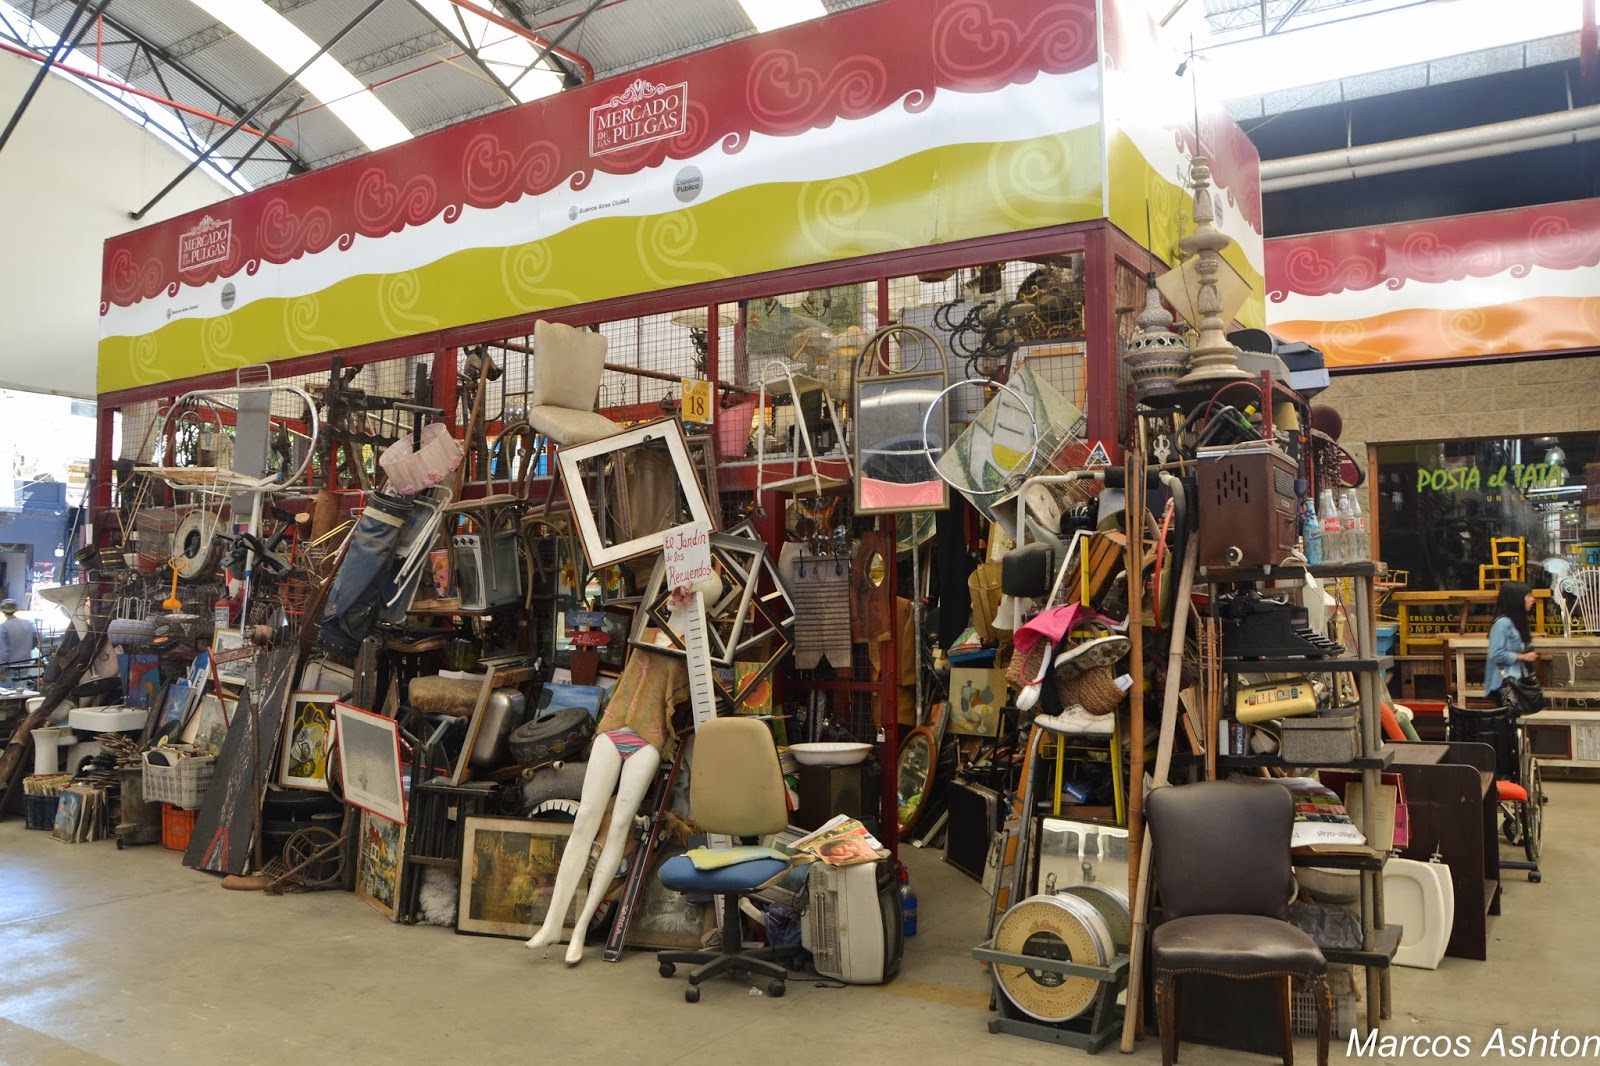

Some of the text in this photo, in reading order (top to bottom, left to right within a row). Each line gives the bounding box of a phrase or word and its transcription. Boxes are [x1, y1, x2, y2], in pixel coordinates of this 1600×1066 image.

[597, 94, 679, 131] MERCADO
[612, 111, 678, 143] PULGAS
[597, 130, 609, 140] DE
[597, 138, 611, 148] LAS
[675, 175, 700, 187] Espacio
[676, 183, 700, 193] Público
[579, 197, 630, 214] Buenos Aires Ciudad
[183, 228, 227, 252] MERCADO
[191, 241, 226, 263] PULGAS
[689, 395, 704, 416] 18
[1416, 463, 1563, 493] POSTA el TATA
[665, 536, 674, 549] El
[666, 551, 684, 562] de los
[1398, 625, 1451, 633] OMPRA
